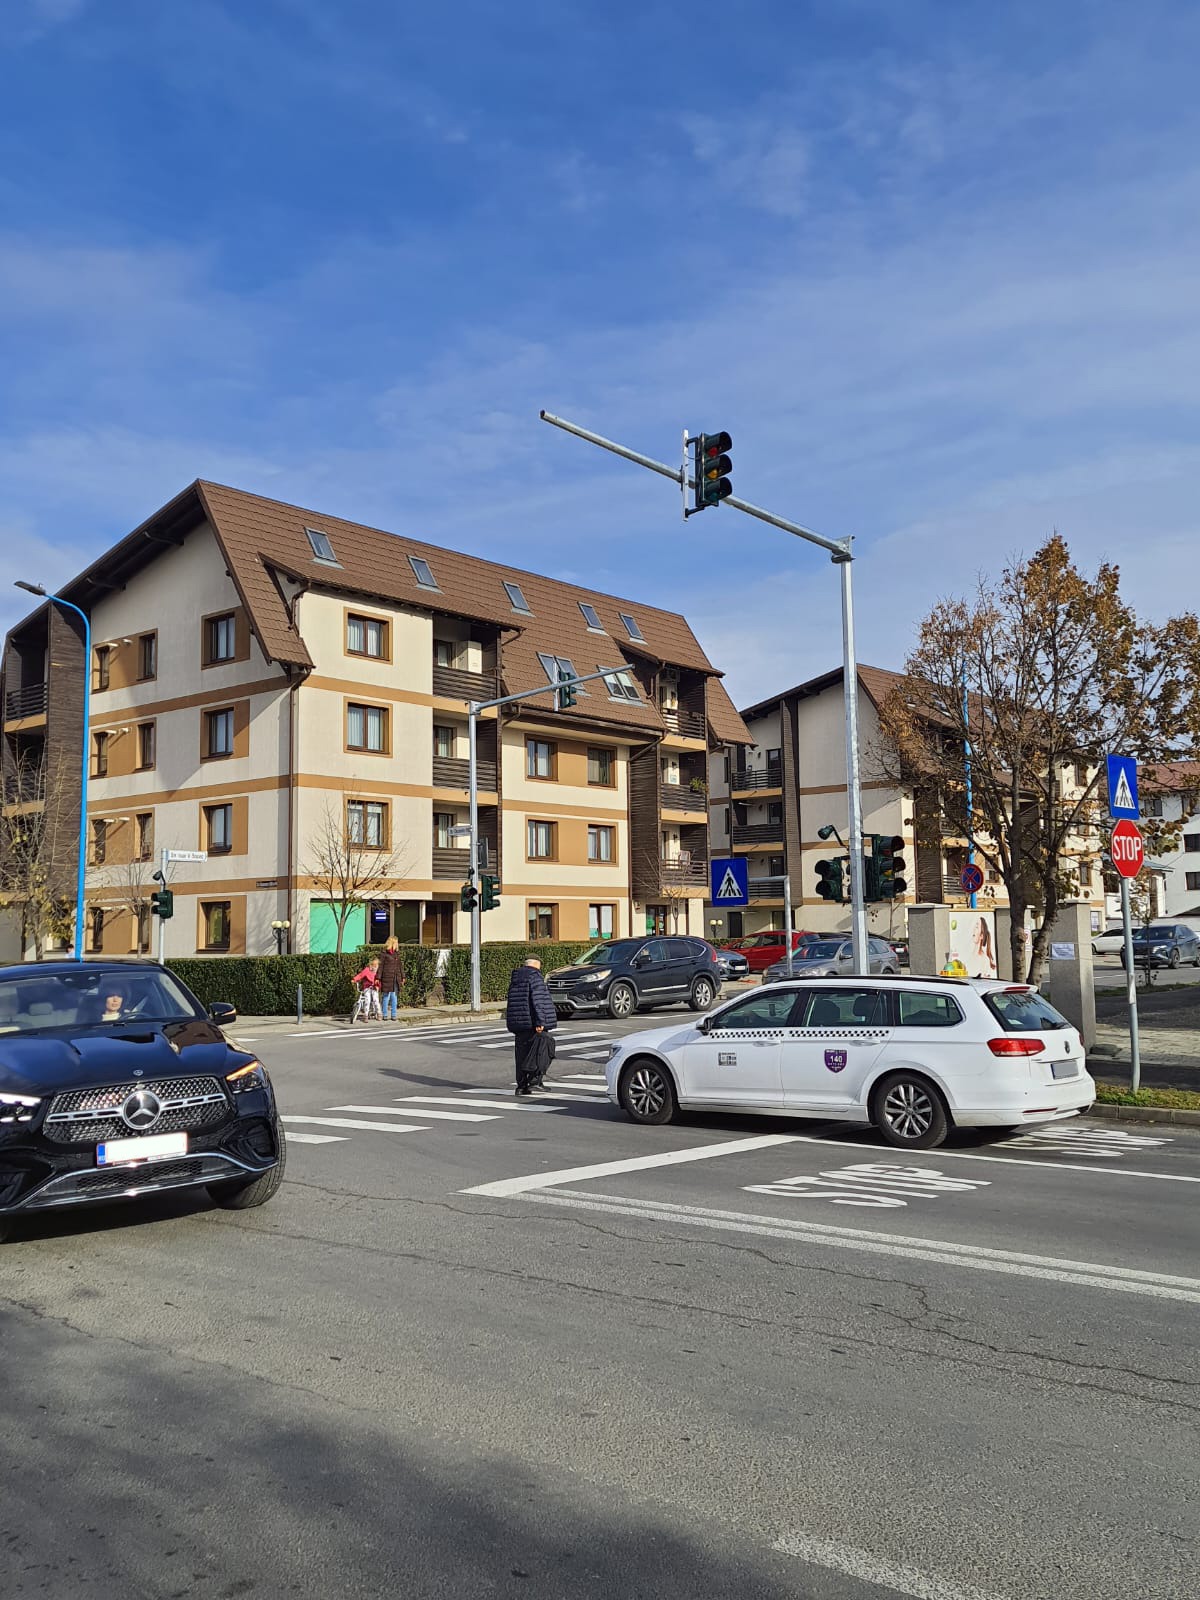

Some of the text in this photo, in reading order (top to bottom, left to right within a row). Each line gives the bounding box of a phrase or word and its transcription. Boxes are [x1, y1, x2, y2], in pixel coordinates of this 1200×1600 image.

[1113, 835, 1142, 862] STOP
[830, 1055, 843, 1063] 140
[989, 1127, 1175, 1157] STOP
[739, 1164, 992, 1208] STOP
